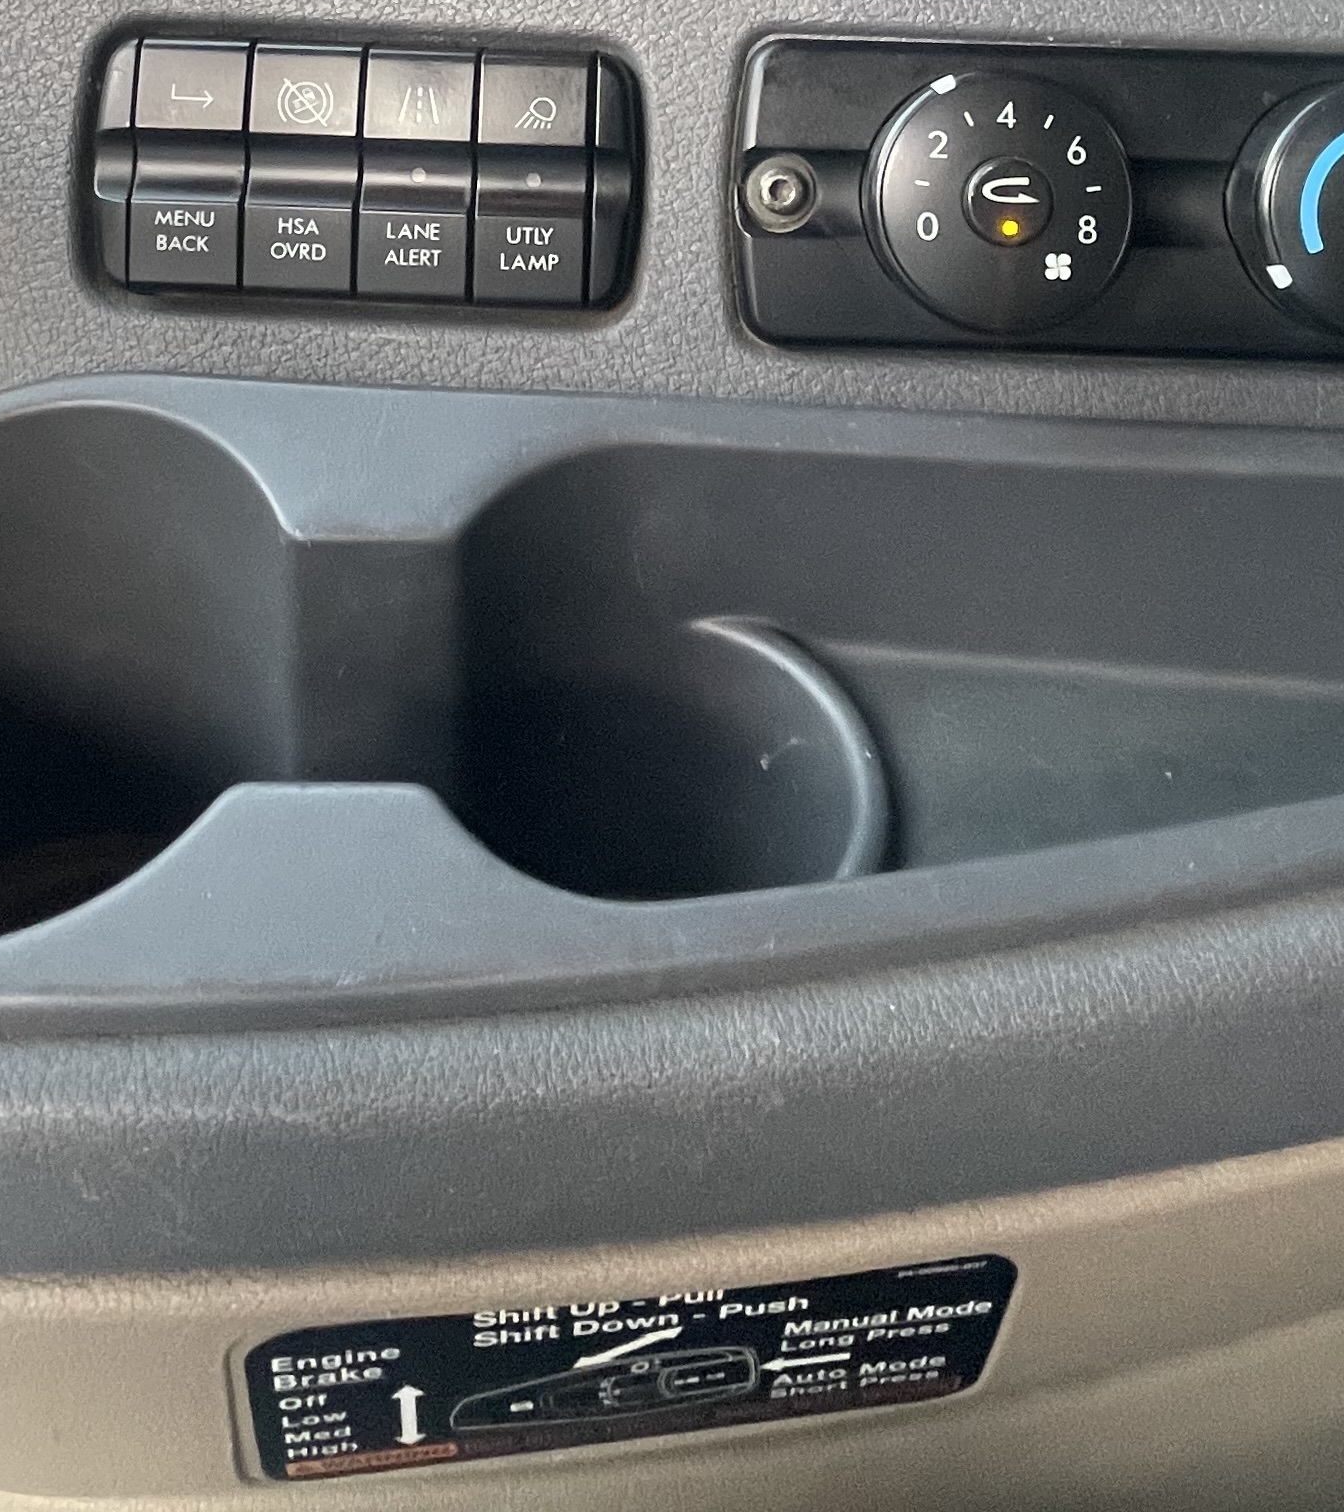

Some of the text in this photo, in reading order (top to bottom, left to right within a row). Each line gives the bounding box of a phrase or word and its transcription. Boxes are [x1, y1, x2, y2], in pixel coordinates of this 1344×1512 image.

[996, 101, 1017, 129] 4
[928, 130, 949, 159] 2
[1066, 135, 1087, 165] 6
[154, 209, 216, 230] MENU
[277, 216, 320, 236] HSA
[916, 211, 939, 241] 0
[1077, 215, 1098, 245] 8
[386, 221, 441, 242] LANE
[506, 226, 554, 246] UTLY
[156, 234, 210, 254] BACK
[269, 241, 327, 262] OVRD
[384, 246, 442, 267] ALERT
[499, 251, 560, 272] LAMP
[473, 1306, 556, 1328] Shift
[570, 1301, 620, 1317] Up
[473, 1325, 560, 1348] Shift
[573, 1311, 679, 1337] Down
[719, 1295, 809, 1319] Push
[784, 1300, 993, 1337] Manual Mode
[781, 1322, 950, 1352] Long Press
[271, 1347, 400, 1373] Engine
[773, 1356, 946, 1387] Auto Mode
[274, 1366, 383, 1392] Brake
[279, 1393, 327, 1410] Off
[282, 1411, 347, 1429] Low
[284, 1425, 352, 1444] Med
[287, 1441, 359, 1459] High
